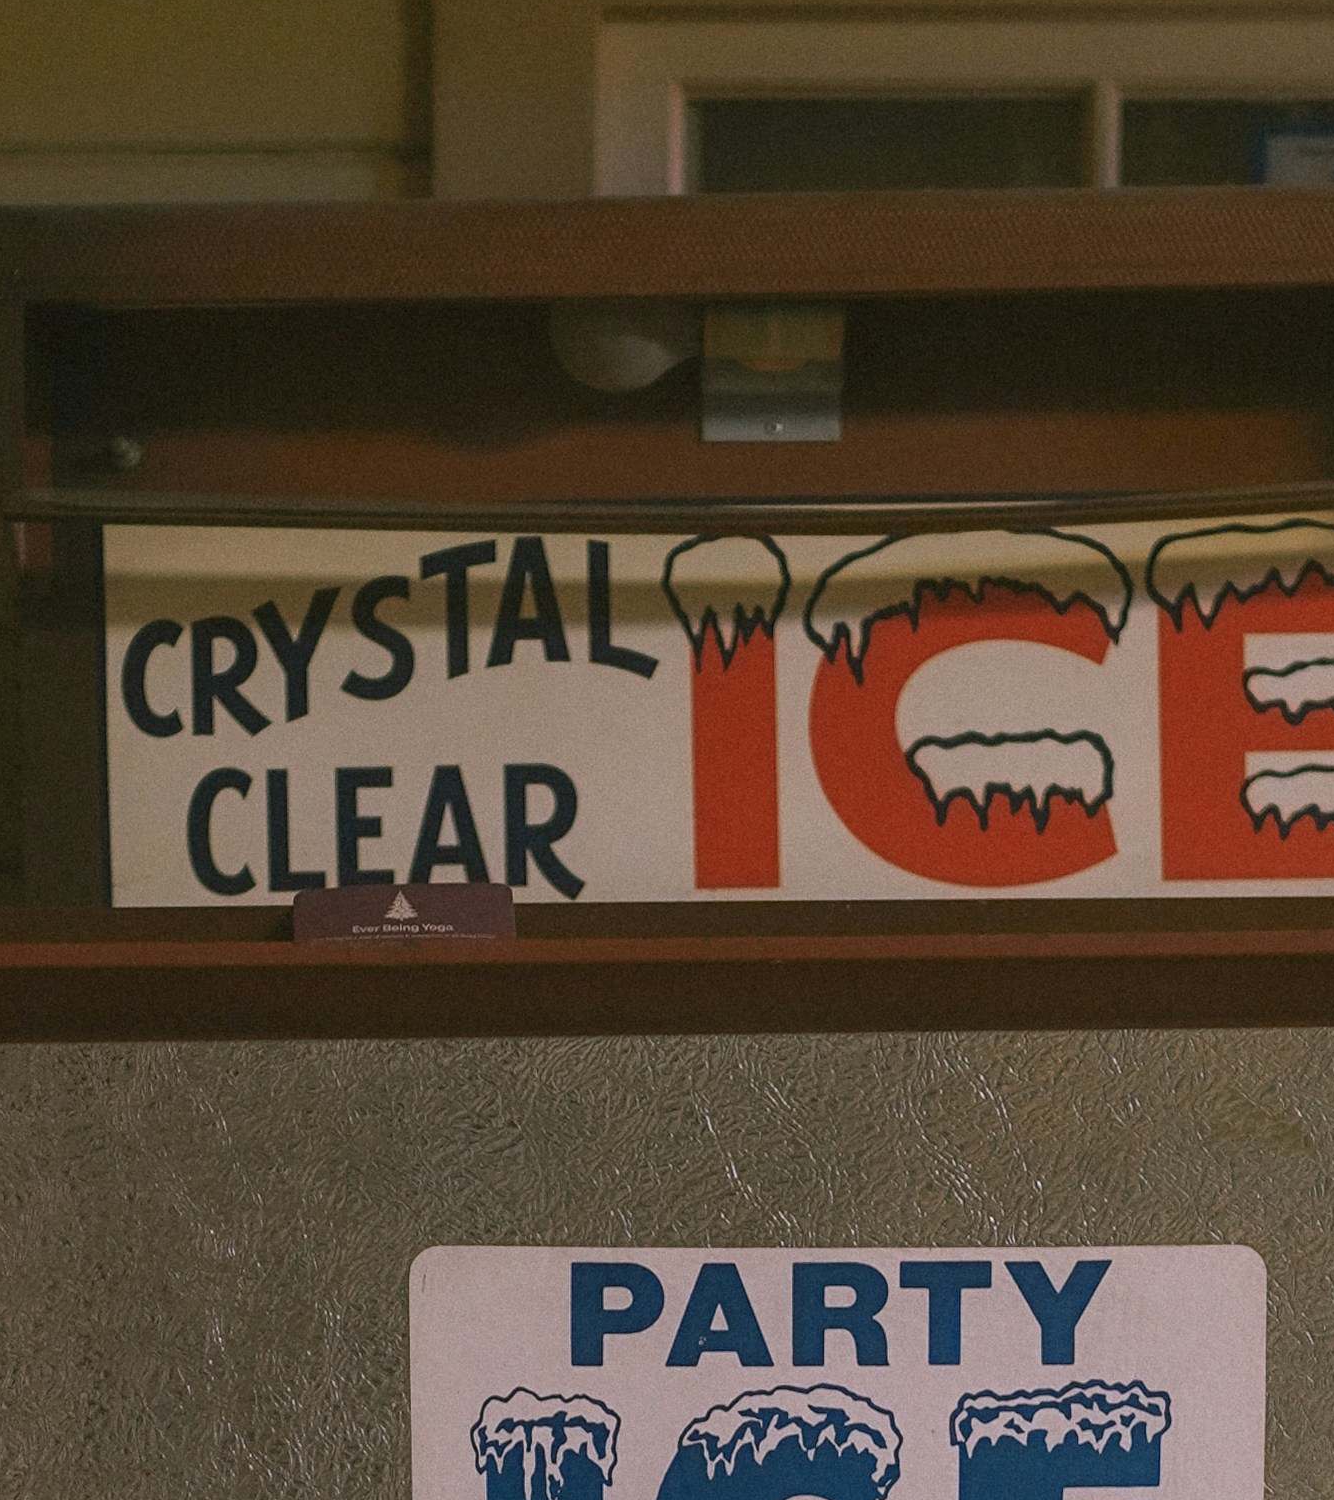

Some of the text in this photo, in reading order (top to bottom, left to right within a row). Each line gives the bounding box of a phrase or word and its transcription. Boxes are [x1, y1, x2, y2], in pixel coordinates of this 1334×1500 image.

[121, 534, 660, 738] CRYSTAL
[185, 762, 587, 900] CLEAR
[352, 924, 454, 933] Ever Being Yoga
[569, 1259, 1114, 1369] PARTY
